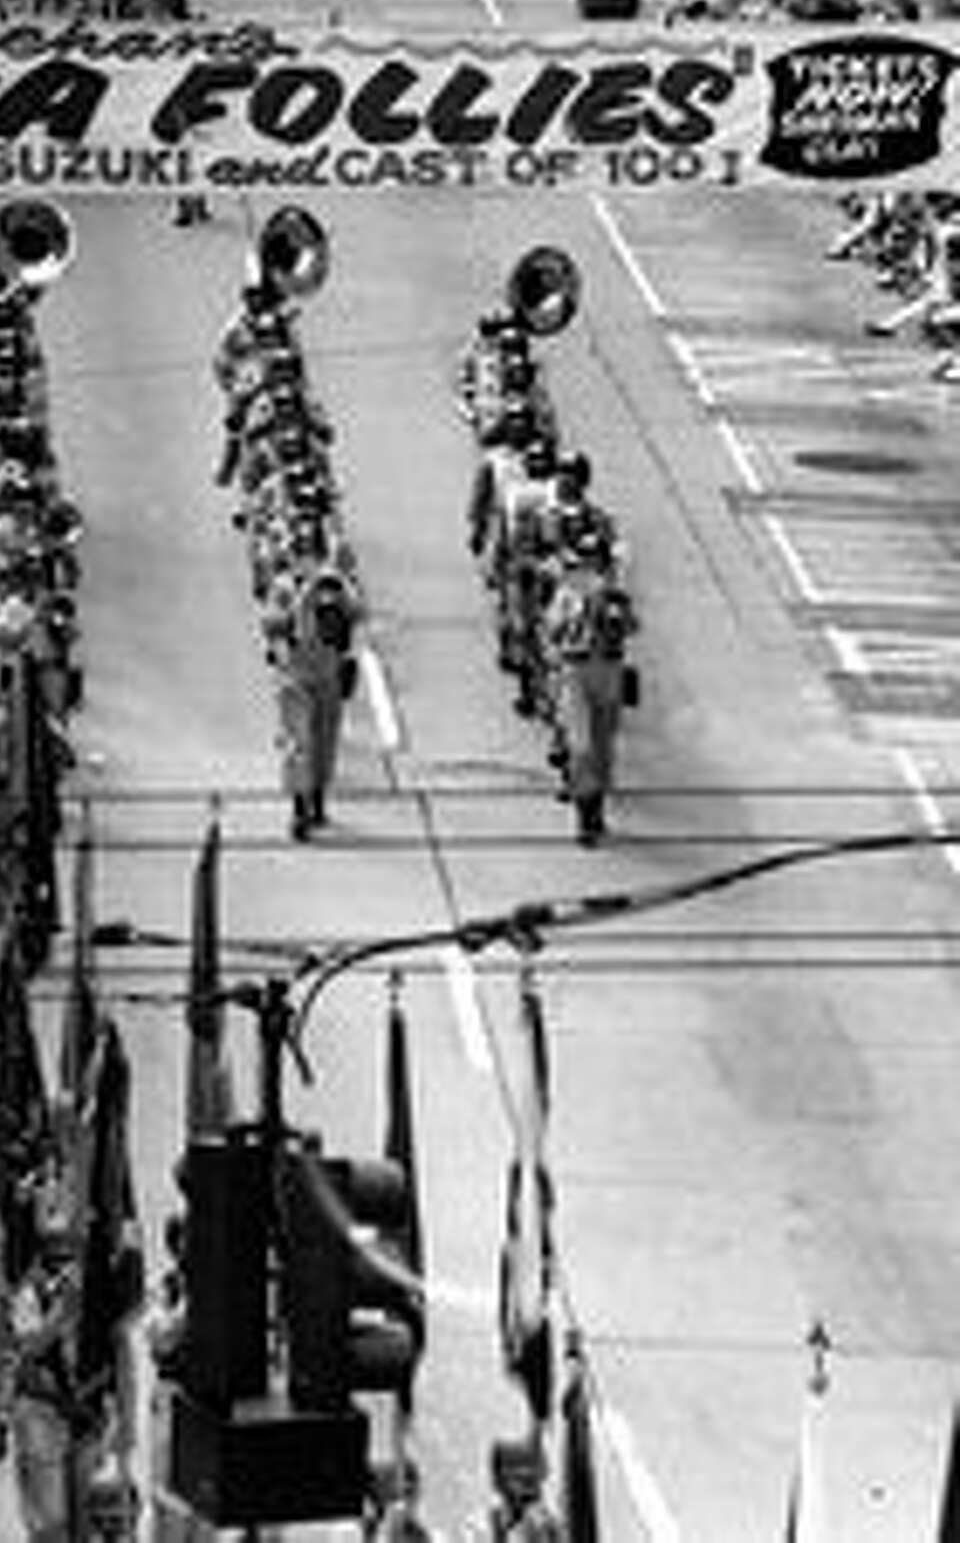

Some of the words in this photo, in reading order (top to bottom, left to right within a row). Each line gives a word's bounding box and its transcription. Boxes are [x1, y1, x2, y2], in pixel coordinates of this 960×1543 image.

[206, 145, 330, 186] and
[336, 149, 488, 185] CAST
[506, 149, 577, 186] OF
